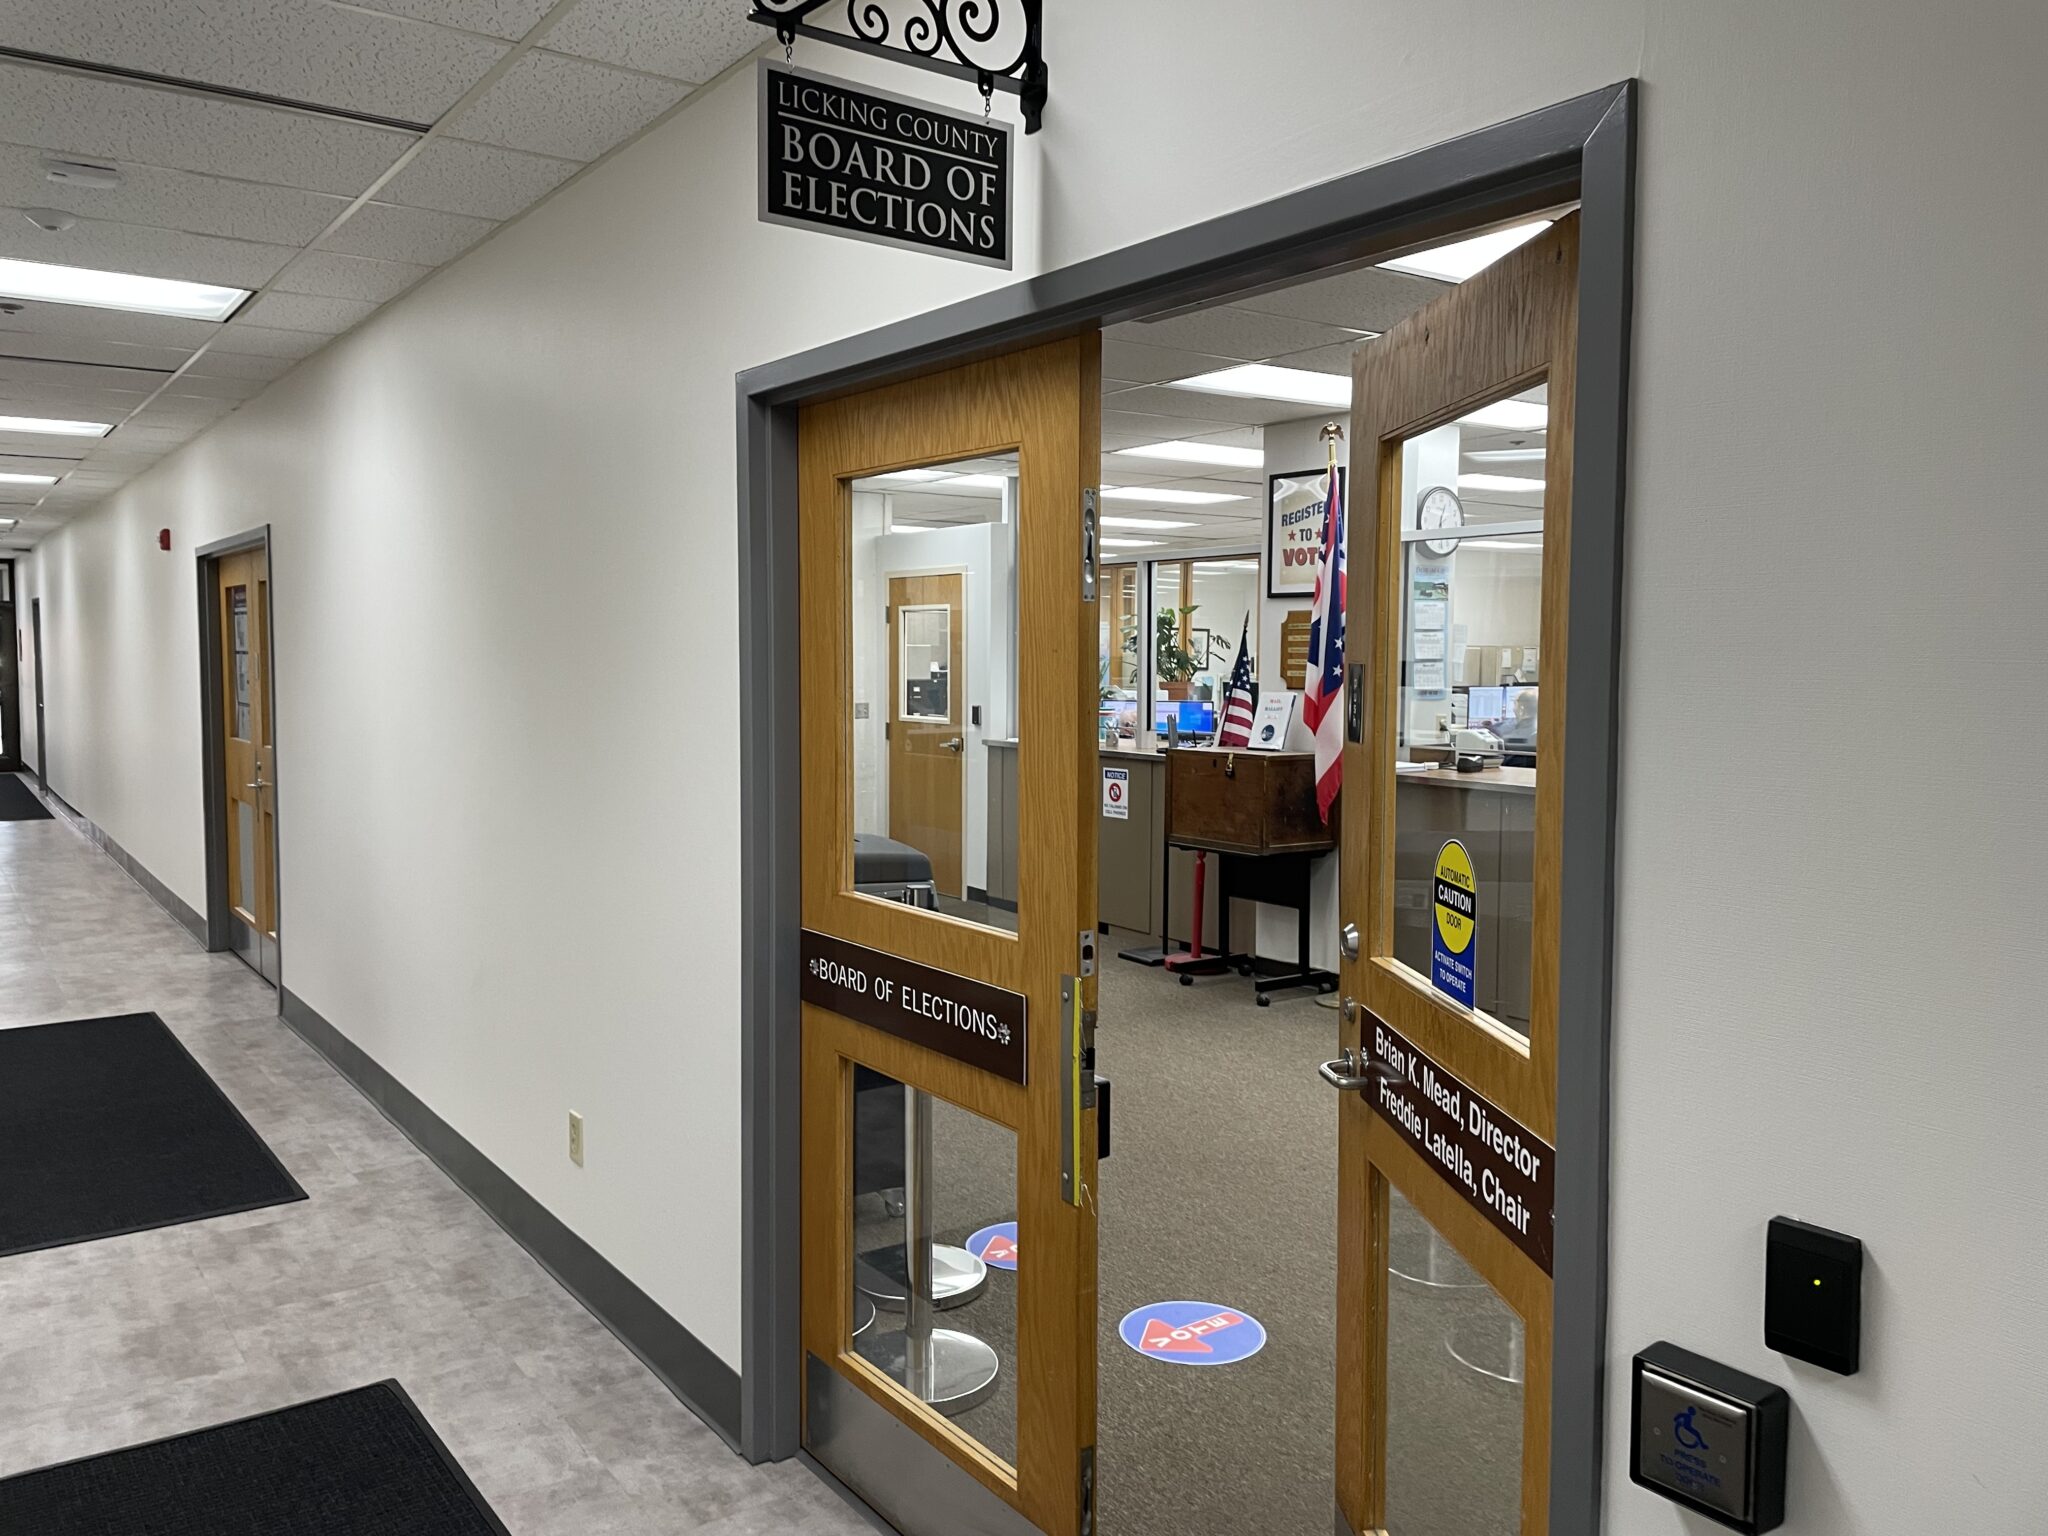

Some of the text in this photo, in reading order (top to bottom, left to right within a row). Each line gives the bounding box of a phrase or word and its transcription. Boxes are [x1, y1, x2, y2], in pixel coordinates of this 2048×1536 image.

[778, 81, 999, 157] LICKING COUNTY
[781, 123, 996, 206] BOARD OF
[782, 170, 995, 249] ELECTIONS
[1281, 501, 1324, 527] REGISTE
[1299, 528, 1313, 542] TO
[1282, 546, 1321, 567] VOT
[1105, 770, 1126, 780] NOTICE
[1440, 865, 1470, 888] AUTOMATIC
[1438, 884, 1472, 914] CAUTION
[1446, 912, 1462, 931] DOOR
[1434, 949, 1472, 980] ACTIVATE SWITCH
[1439, 967, 1466, 993] TO OPERATE
[819, 958, 998, 1040] BOARD OF ELECTIONS
[1375, 1026, 1541, 1183] Brian K. Mead, Director
[1380, 1076, 1530, 1235] Freddie Latella, Chair
[1148, 1317, 1230, 1349] VOTE
